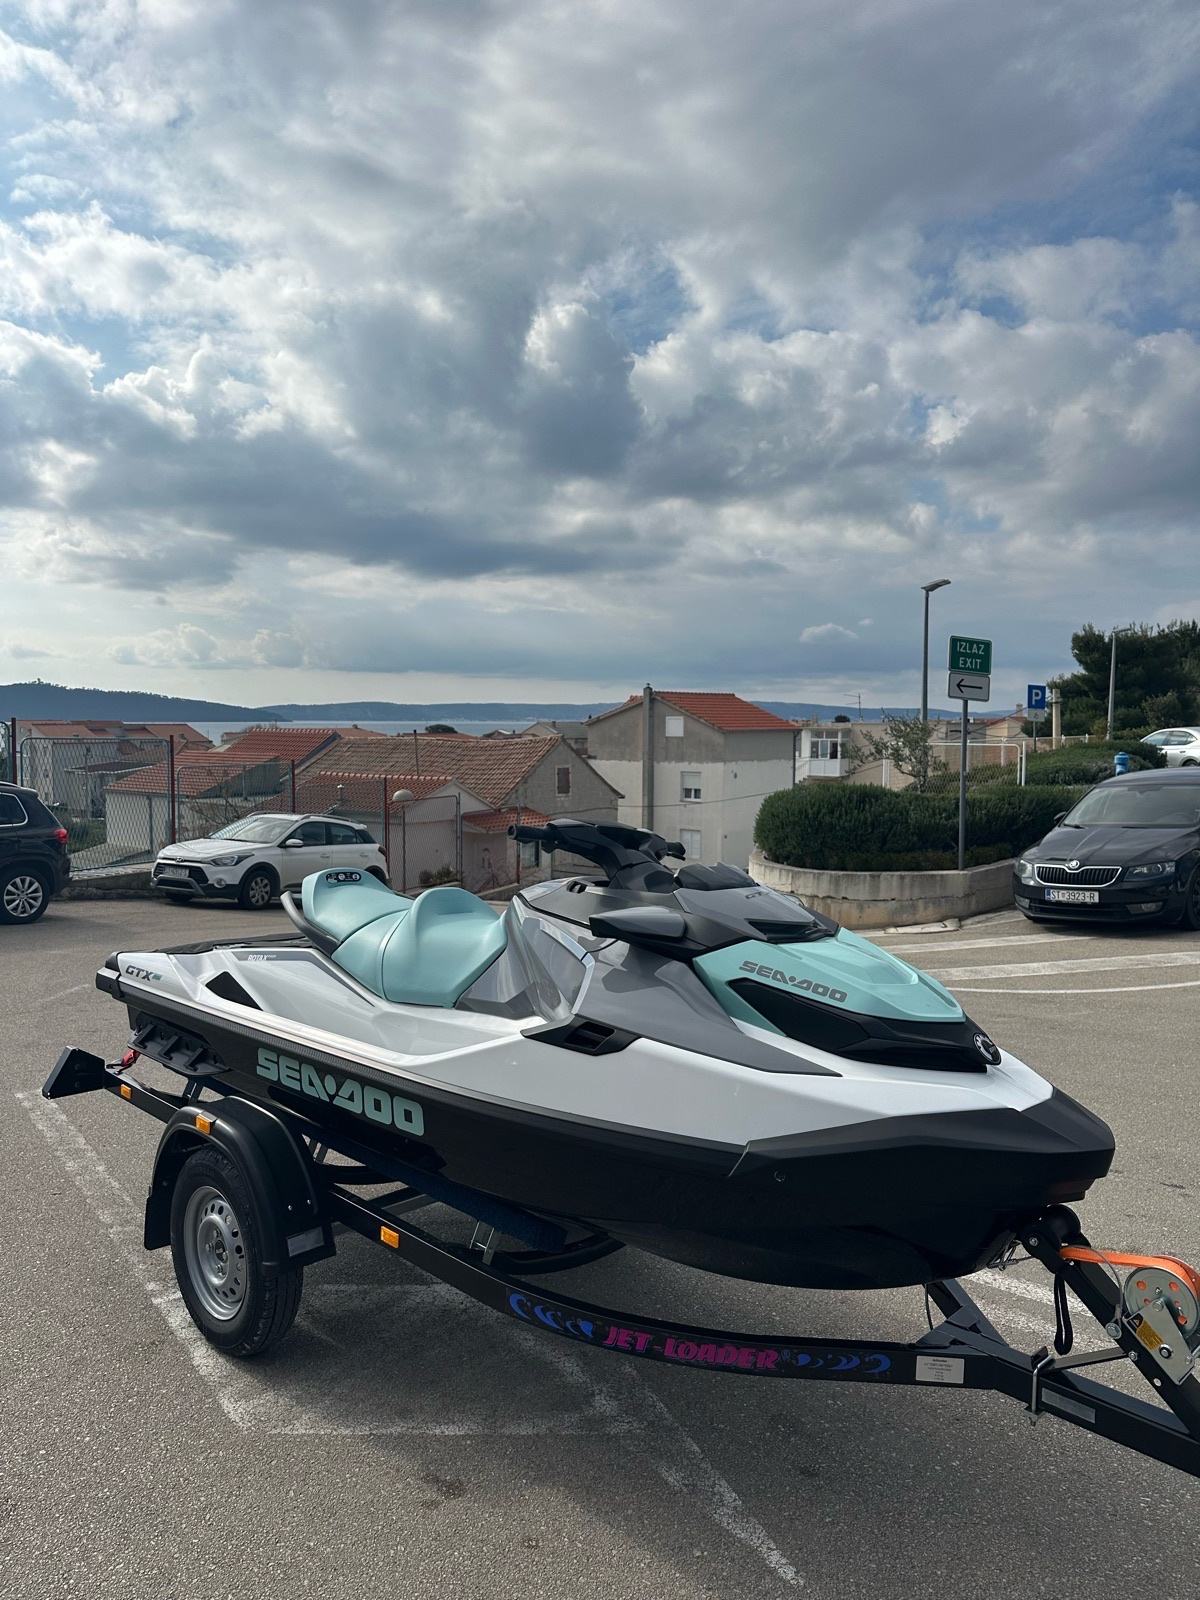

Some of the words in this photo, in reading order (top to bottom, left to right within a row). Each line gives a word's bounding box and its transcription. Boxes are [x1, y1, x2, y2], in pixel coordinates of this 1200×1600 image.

[957, 641, 985, 655] IZLAZ
[959, 657, 982, 669] EXIT
[1031, 689, 1042, 706] P
[125, 964, 154, 981] GTX
